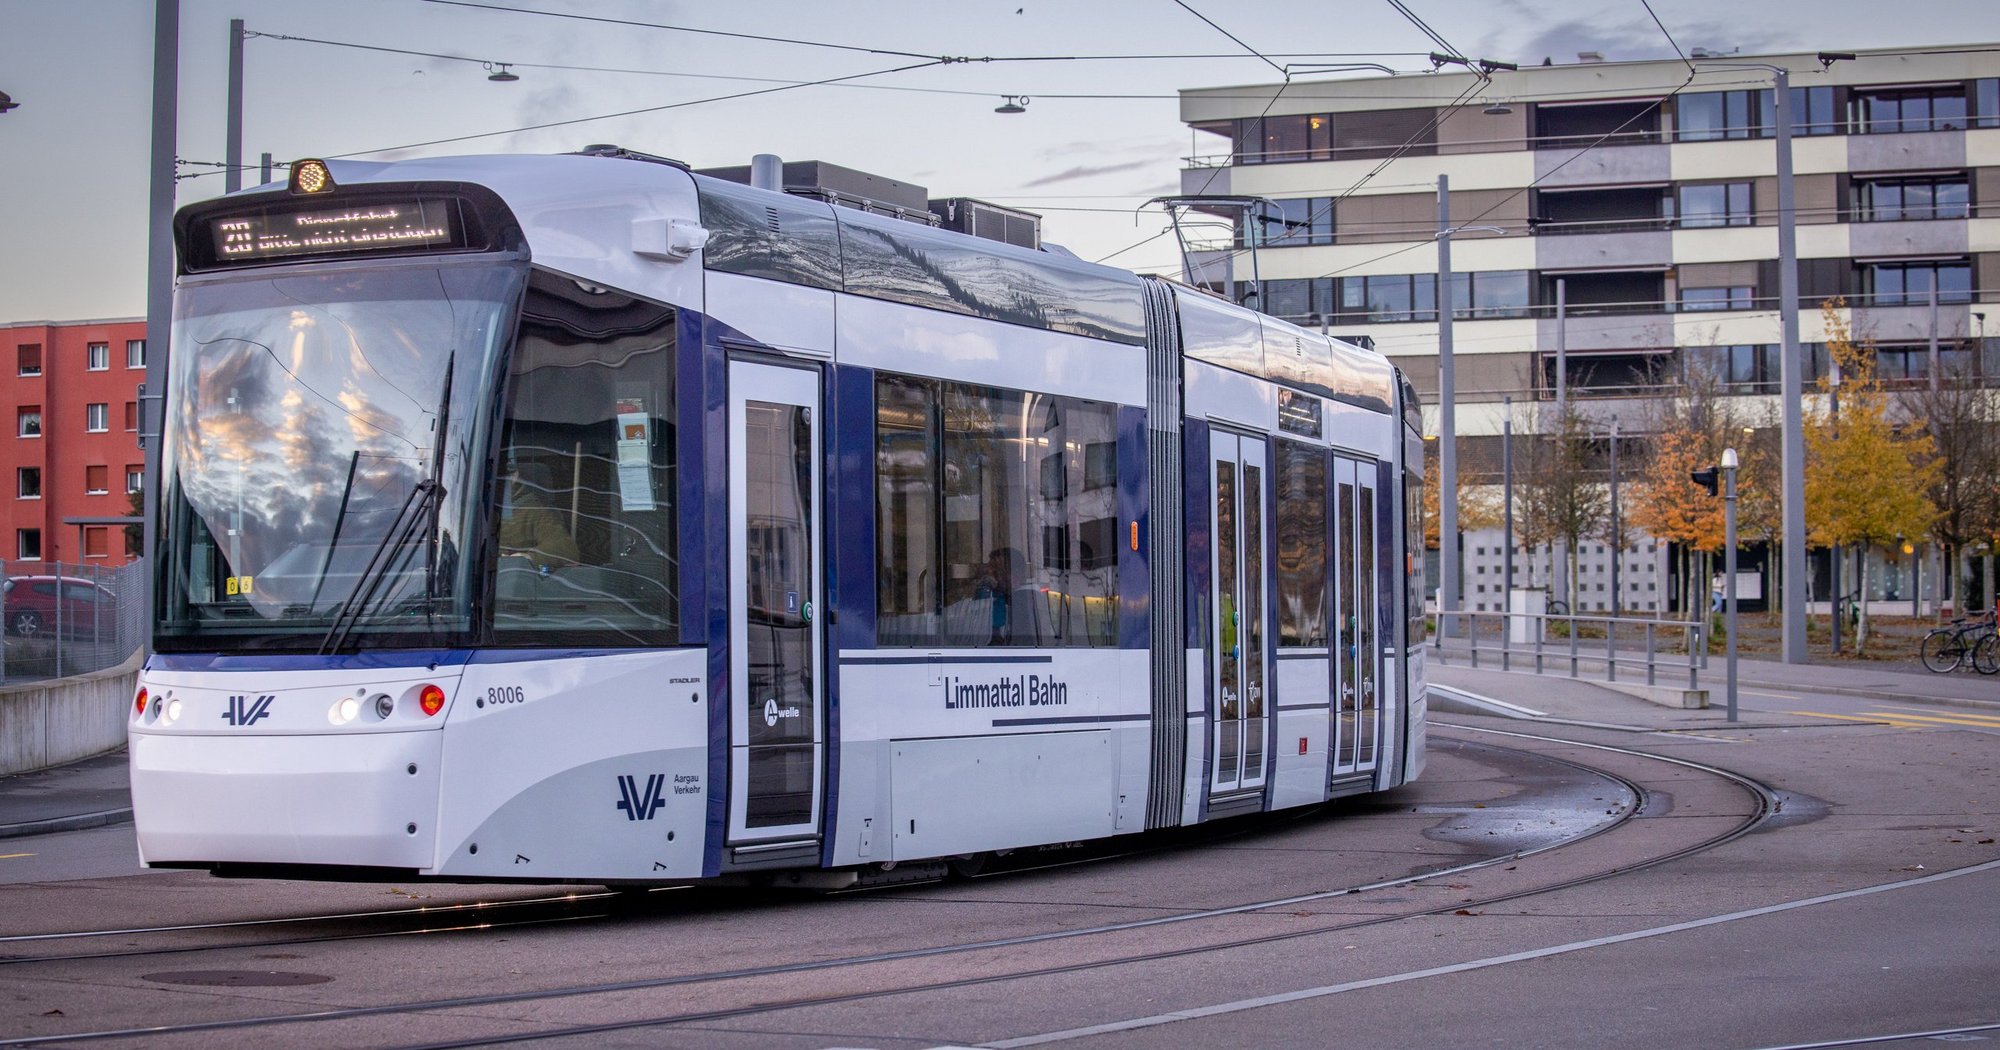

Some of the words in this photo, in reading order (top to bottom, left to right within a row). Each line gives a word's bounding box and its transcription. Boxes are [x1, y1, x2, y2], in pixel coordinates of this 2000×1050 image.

[488, 685, 525, 705] 8006
[945, 674, 1025, 709] Limmattal
[1029, 674, 1067, 706] Bahn
[673, 773, 700, 784] Aargau
[673, 785, 702, 795] Verkehr
